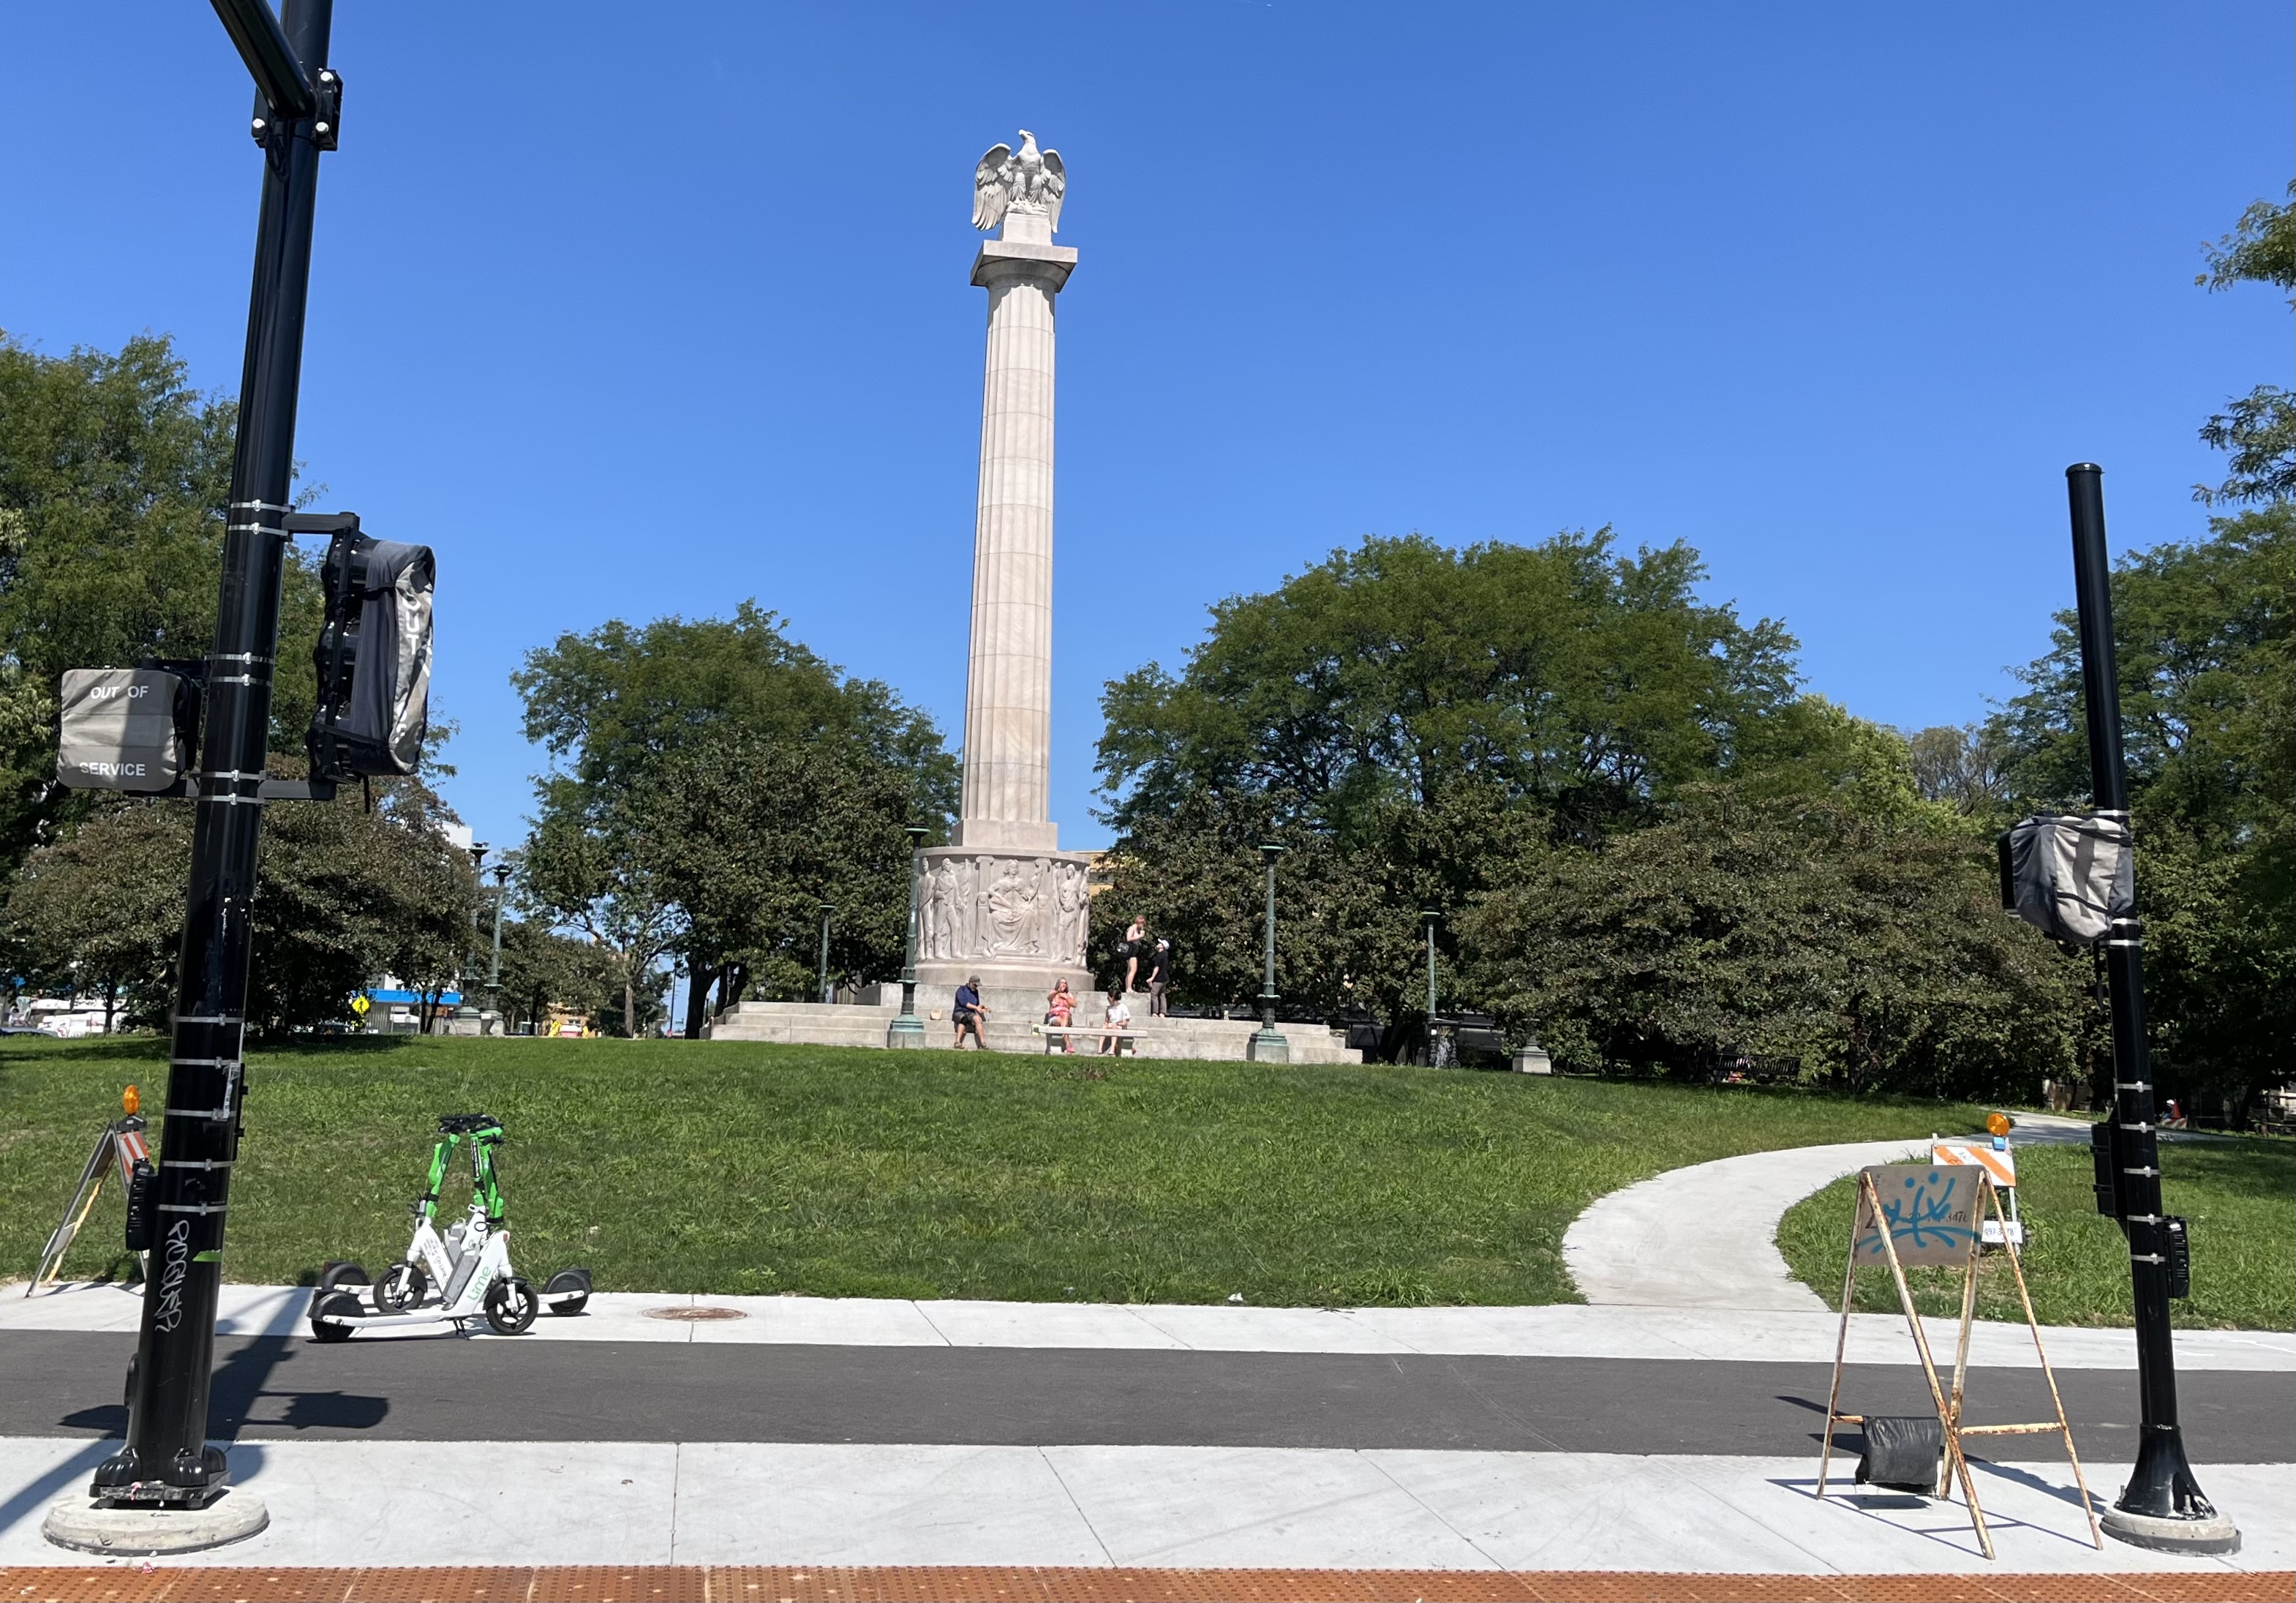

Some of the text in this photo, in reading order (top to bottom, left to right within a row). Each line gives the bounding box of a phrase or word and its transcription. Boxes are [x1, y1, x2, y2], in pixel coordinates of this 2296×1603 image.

[90, 686, 149, 699] OUT OF
[78, 762, 146, 776] SERVICE
[467, 1266, 492, 1301] Lime
